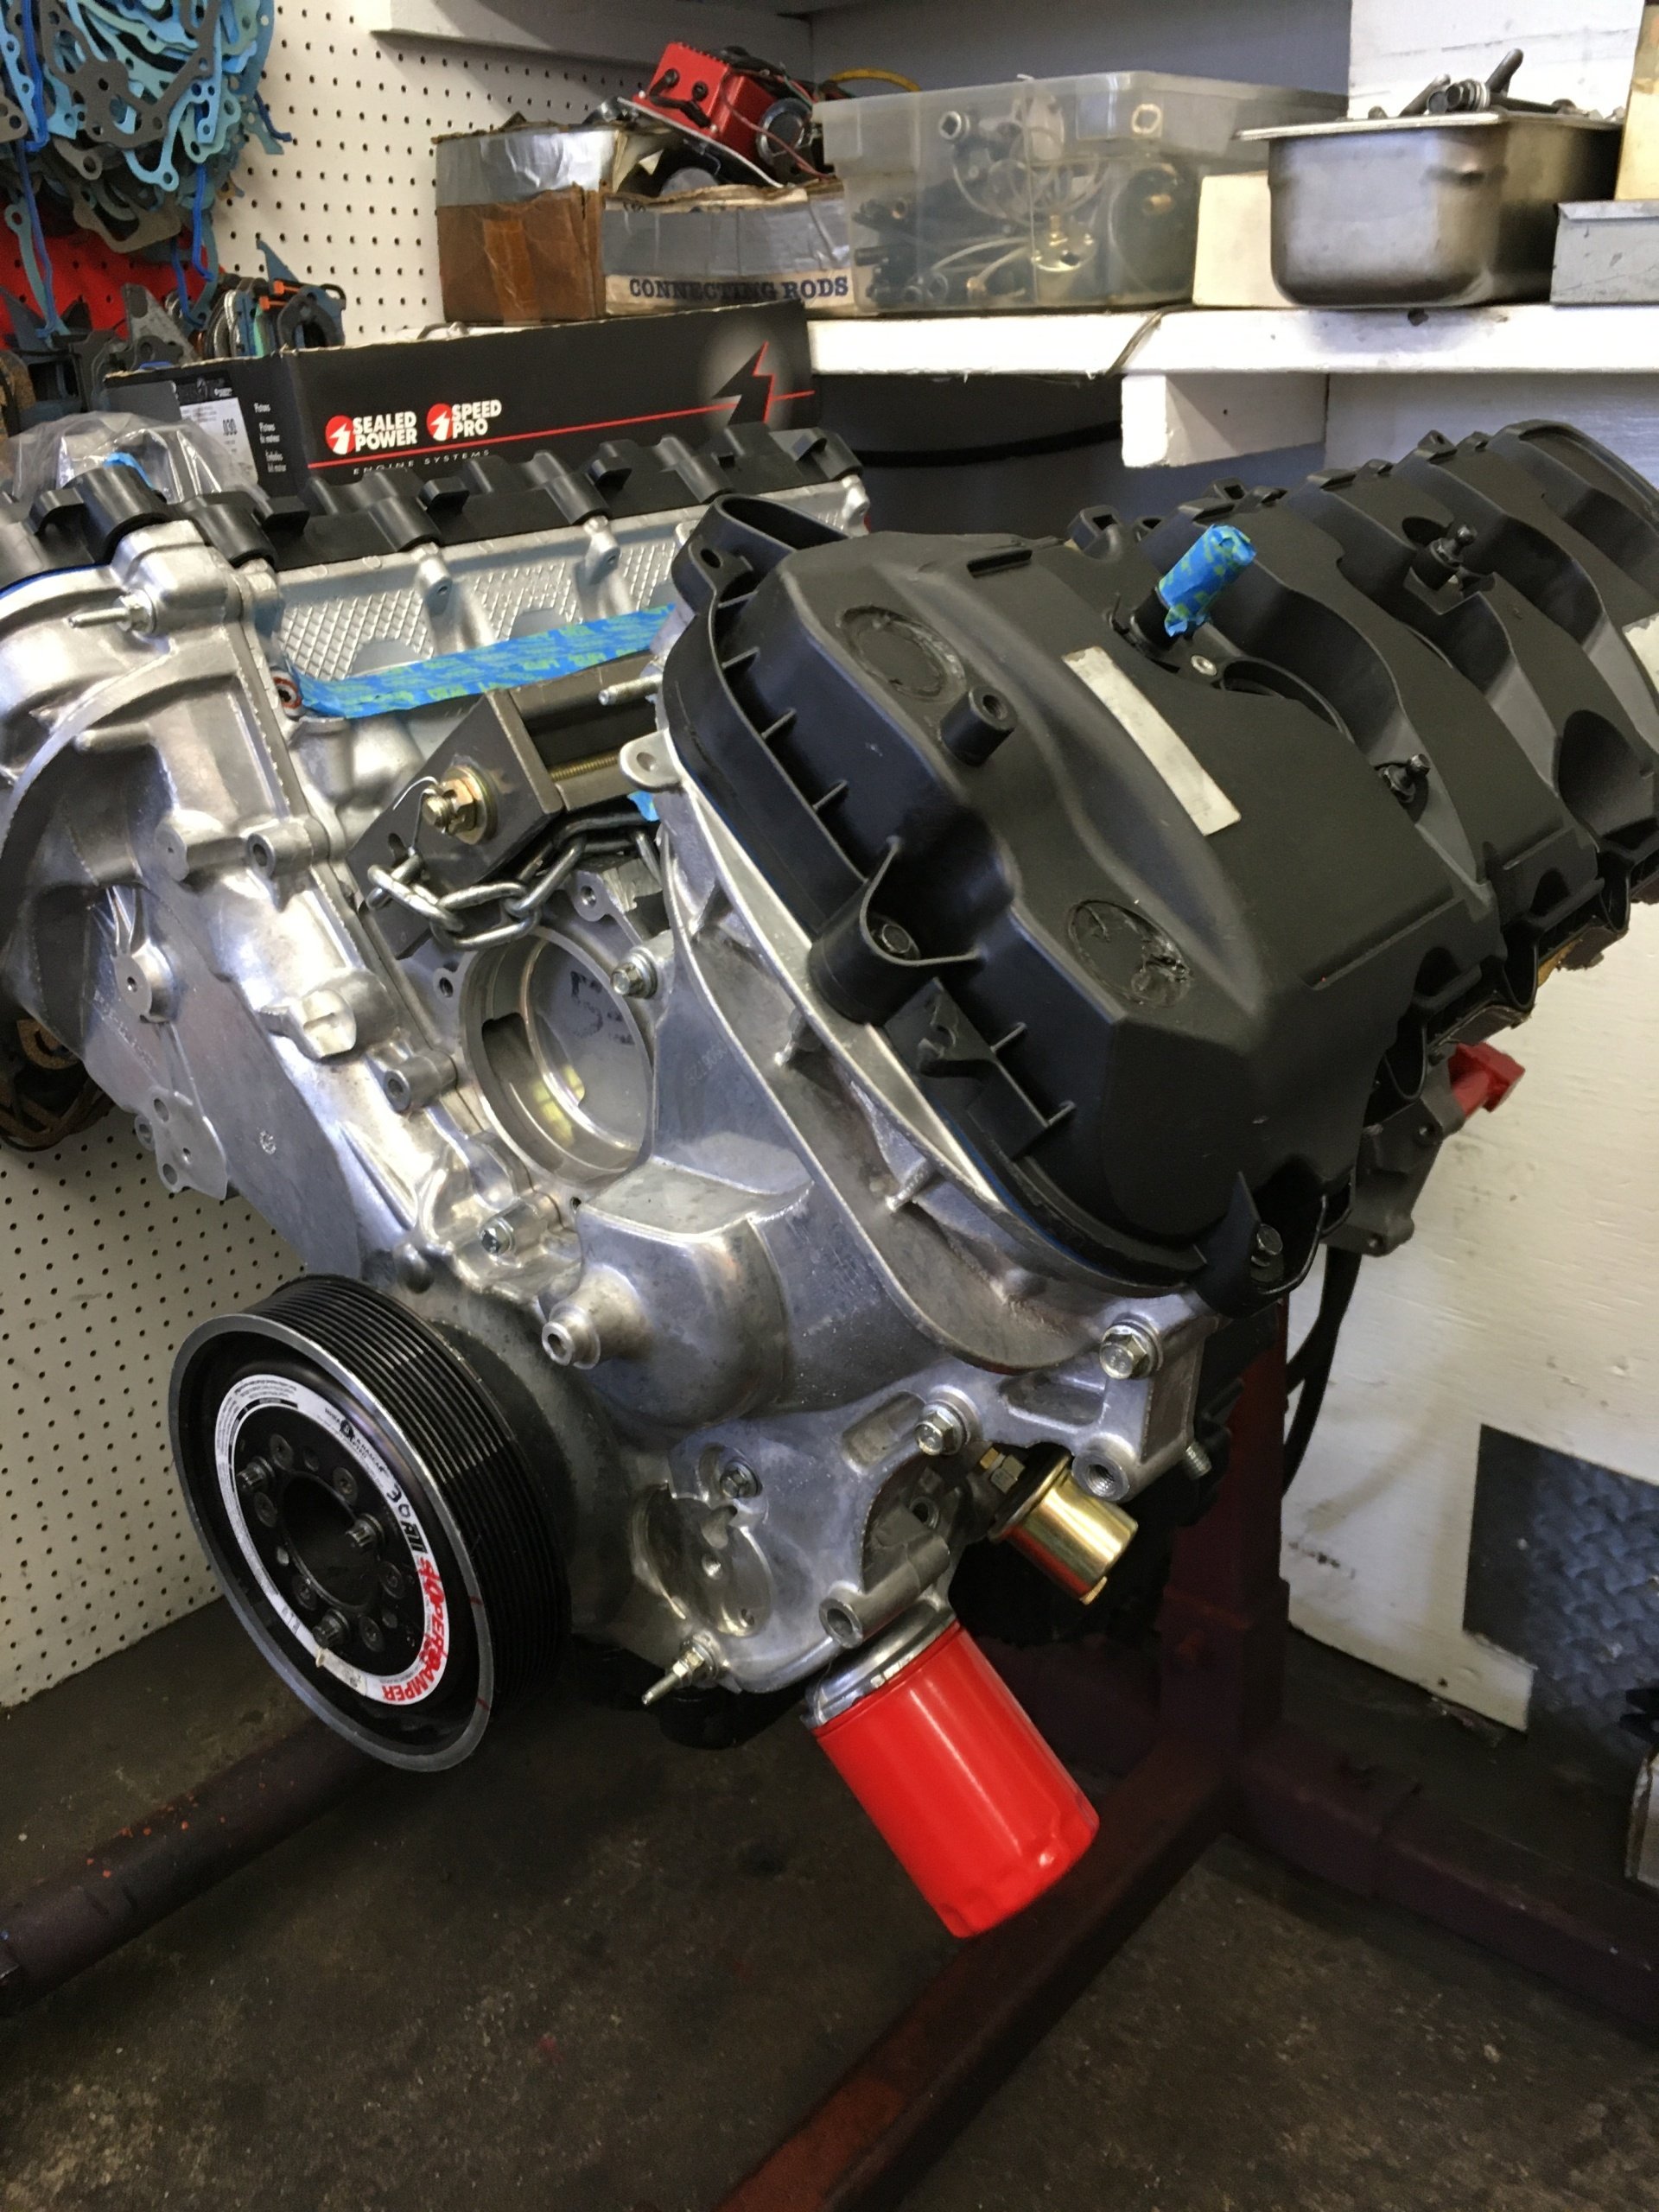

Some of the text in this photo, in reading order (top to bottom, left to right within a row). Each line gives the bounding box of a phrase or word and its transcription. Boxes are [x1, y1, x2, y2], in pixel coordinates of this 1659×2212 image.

[630, 276, 849, 301] CONNECTING RODS
[353, 411, 416, 434] SEALED
[451, 399, 501, 422] SPEED
[355, 428, 417, 452] POWER
[453, 418, 488, 439] PRO
[353, 449, 490, 475] ENGINE SYSTEMS
[418, 1557, 445, 1650] SPER
